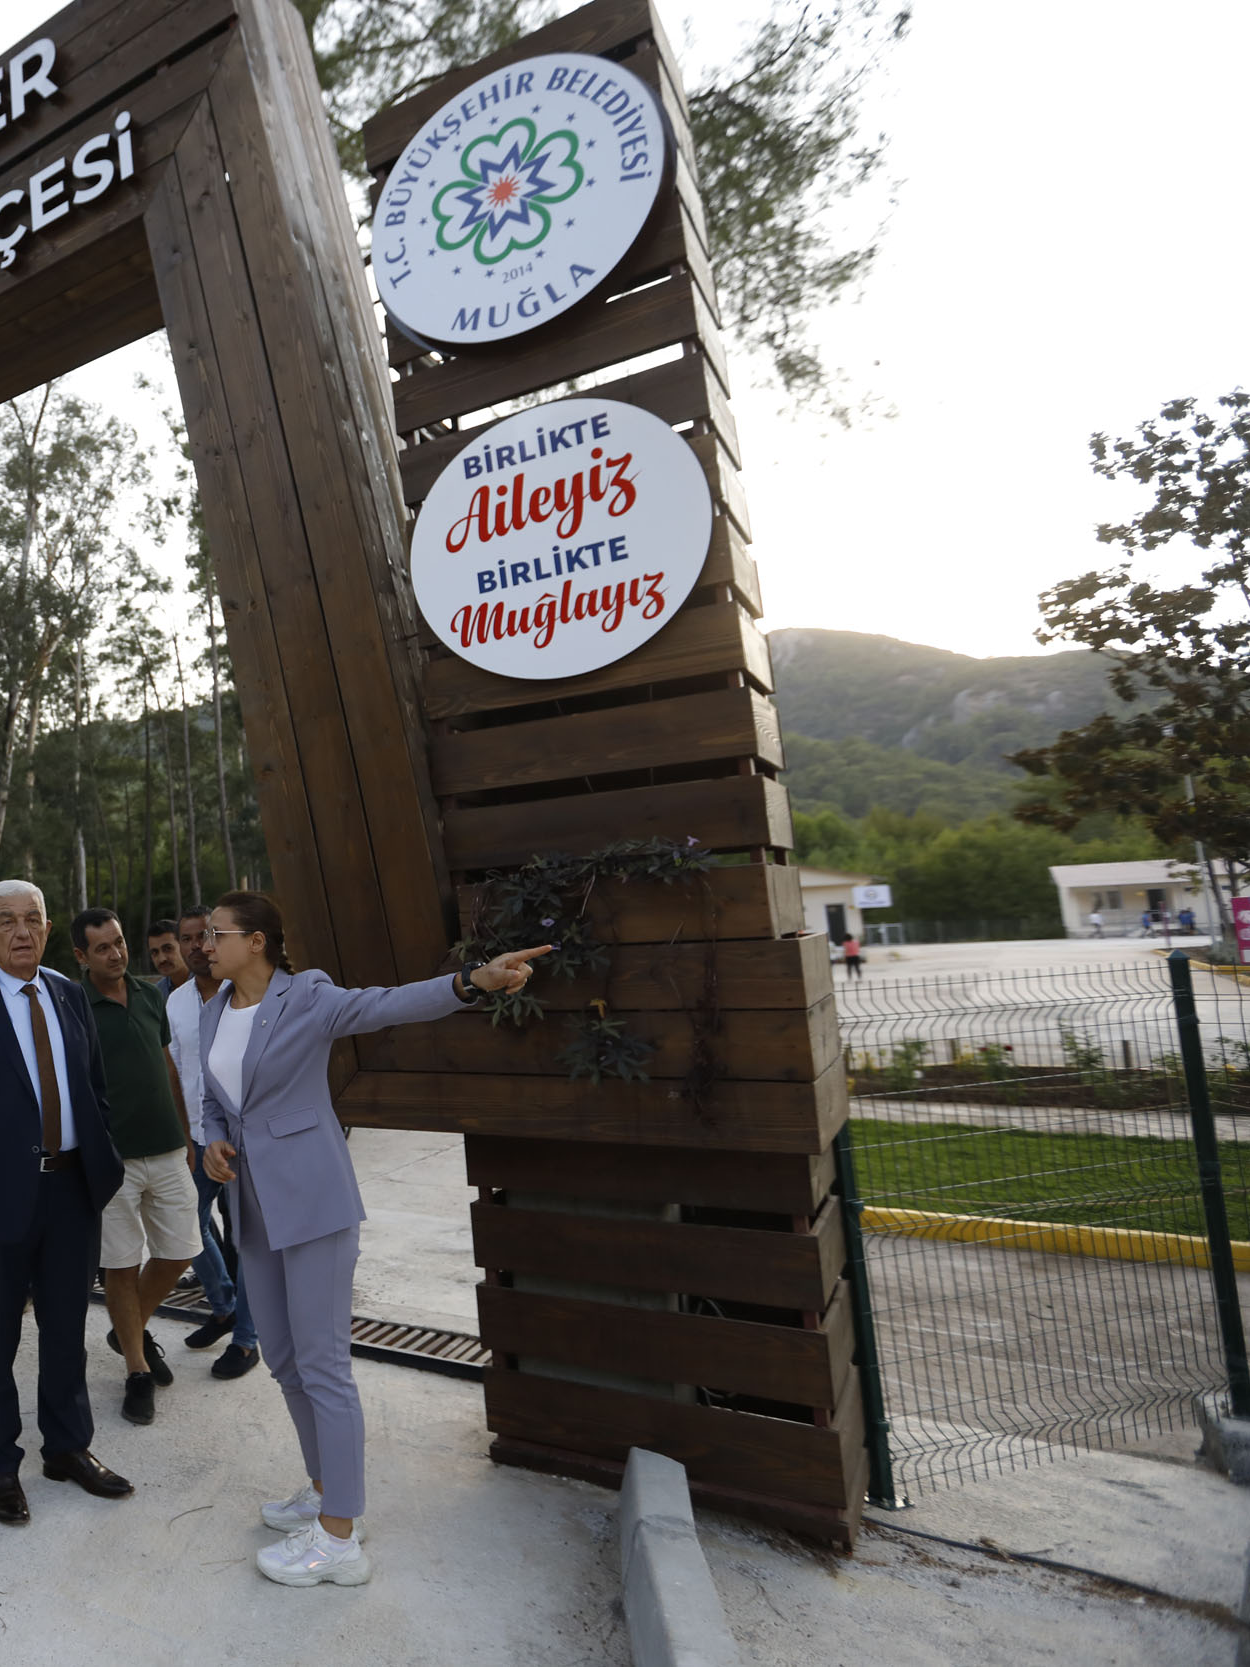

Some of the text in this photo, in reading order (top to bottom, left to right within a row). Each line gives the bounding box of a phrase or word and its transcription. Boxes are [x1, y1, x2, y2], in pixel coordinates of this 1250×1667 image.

[384, 66, 653, 289] T.C. BÜYÜKŞEHİR BELEDİYESİ
[451, 263, 596, 331] MUĞLA
[501, 262, 534, 284] 2014
[462, 412, 611, 480] BİRLİKTE
[445, 447, 643, 553] Aileyiz
[476, 535, 629, 594] BİRLİKTE
